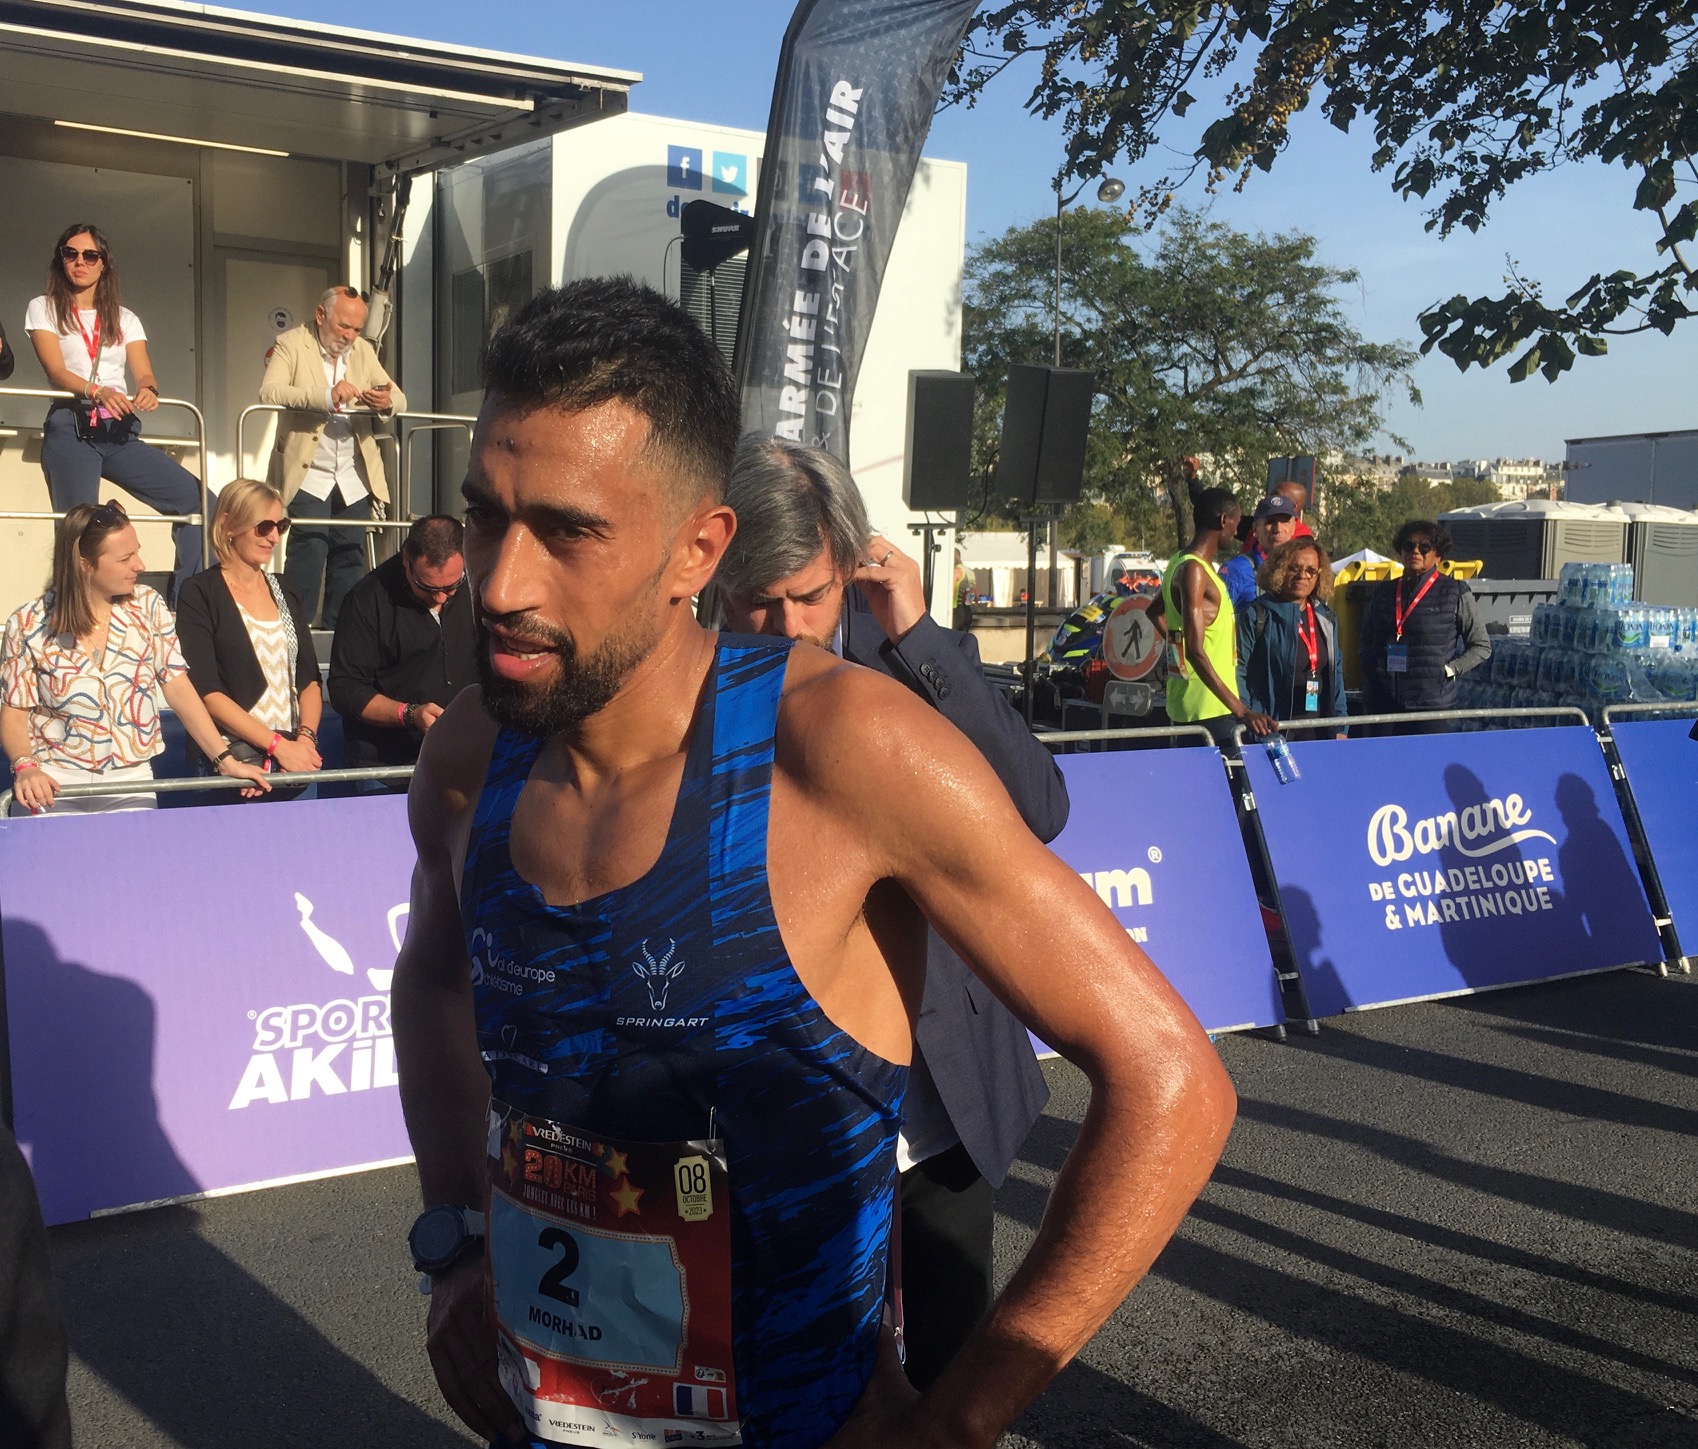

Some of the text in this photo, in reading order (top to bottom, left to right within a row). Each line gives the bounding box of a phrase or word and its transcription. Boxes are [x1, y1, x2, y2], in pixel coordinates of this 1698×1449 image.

[711, 225, 741, 233] SHURE
[774, 290, 821, 442] ARMÉE
[800, 212, 832, 272] DE
[816, 366, 842, 416] DE
[1367, 793, 1557, 867] Banane
[1369, 858, 1555, 901] DE GUADELOUPE
[1385, 886, 1553, 930] & MARTINIQUE
[252, 994, 393, 1051] SPOR
[616, 1017, 709, 1027] SPRINGART
[532, 1126, 592, 1151] VREDESTEIN
[524, 1149, 562, 1189] 20
[679, 1163, 706, 1194] 08
[682, 1194, 707, 1203] OCTOBRE
[688, 1207, 702, 1215] 2023
[538, 1227, 579, 1308] 2
[529, 1305, 602, 1340] MORHAD
[549, 1419, 595, 1432] VREDESTEIN
